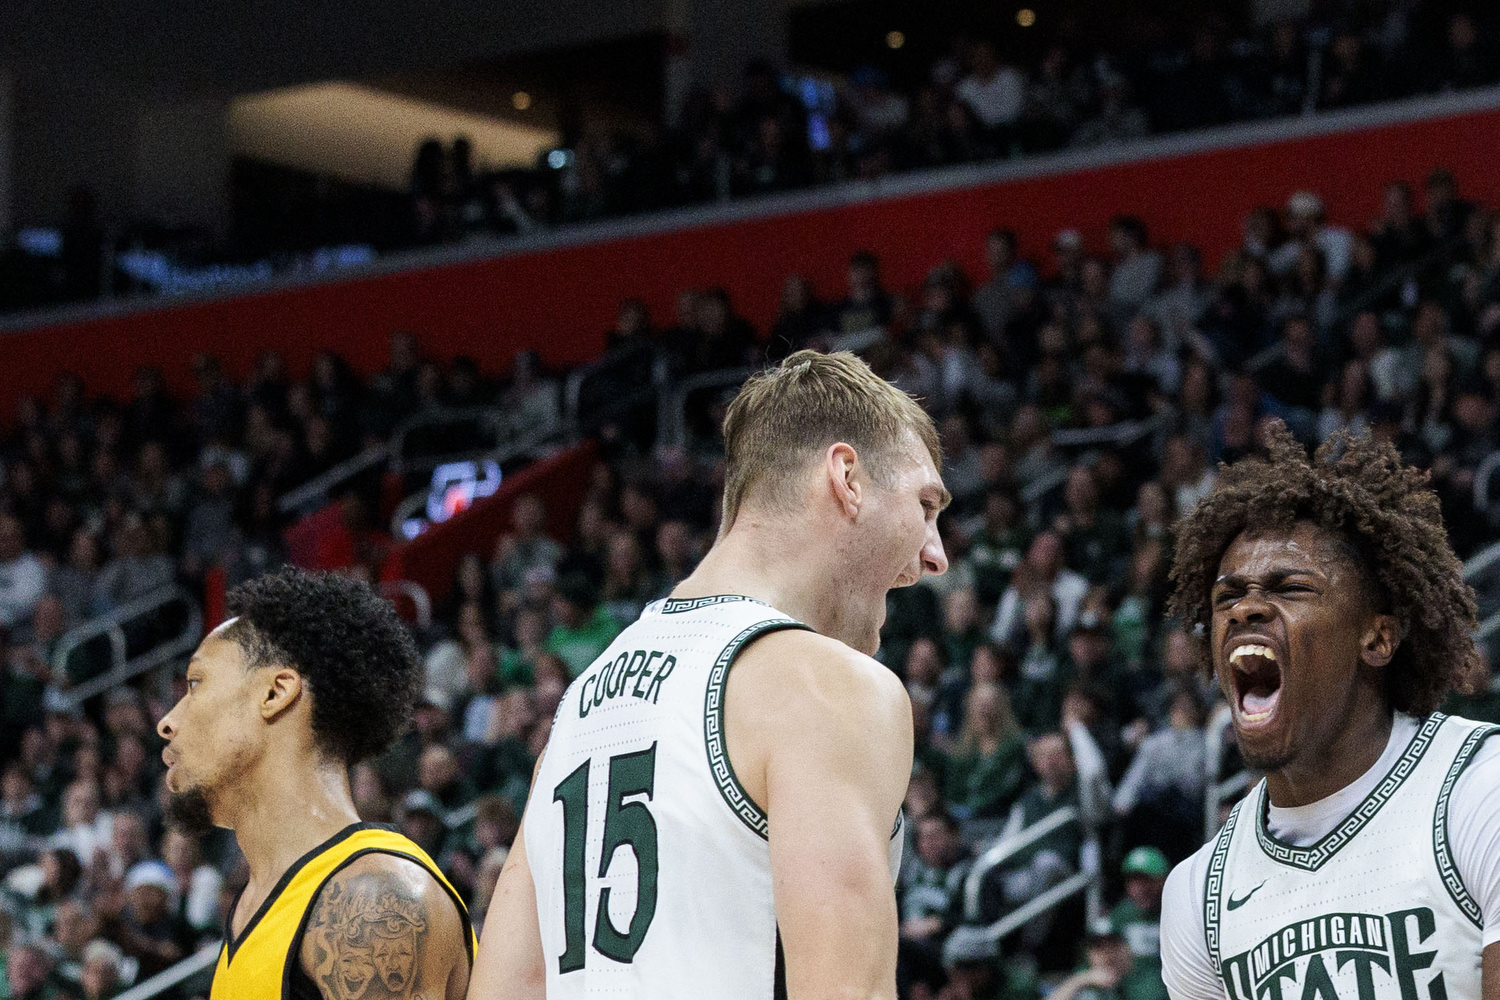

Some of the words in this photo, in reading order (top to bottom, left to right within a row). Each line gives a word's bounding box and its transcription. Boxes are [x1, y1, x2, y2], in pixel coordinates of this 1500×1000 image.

[579, 650, 677, 718] COOPER
[553, 740, 660, 974] 15
[1253, 915, 1383, 979] MICHIGAN
